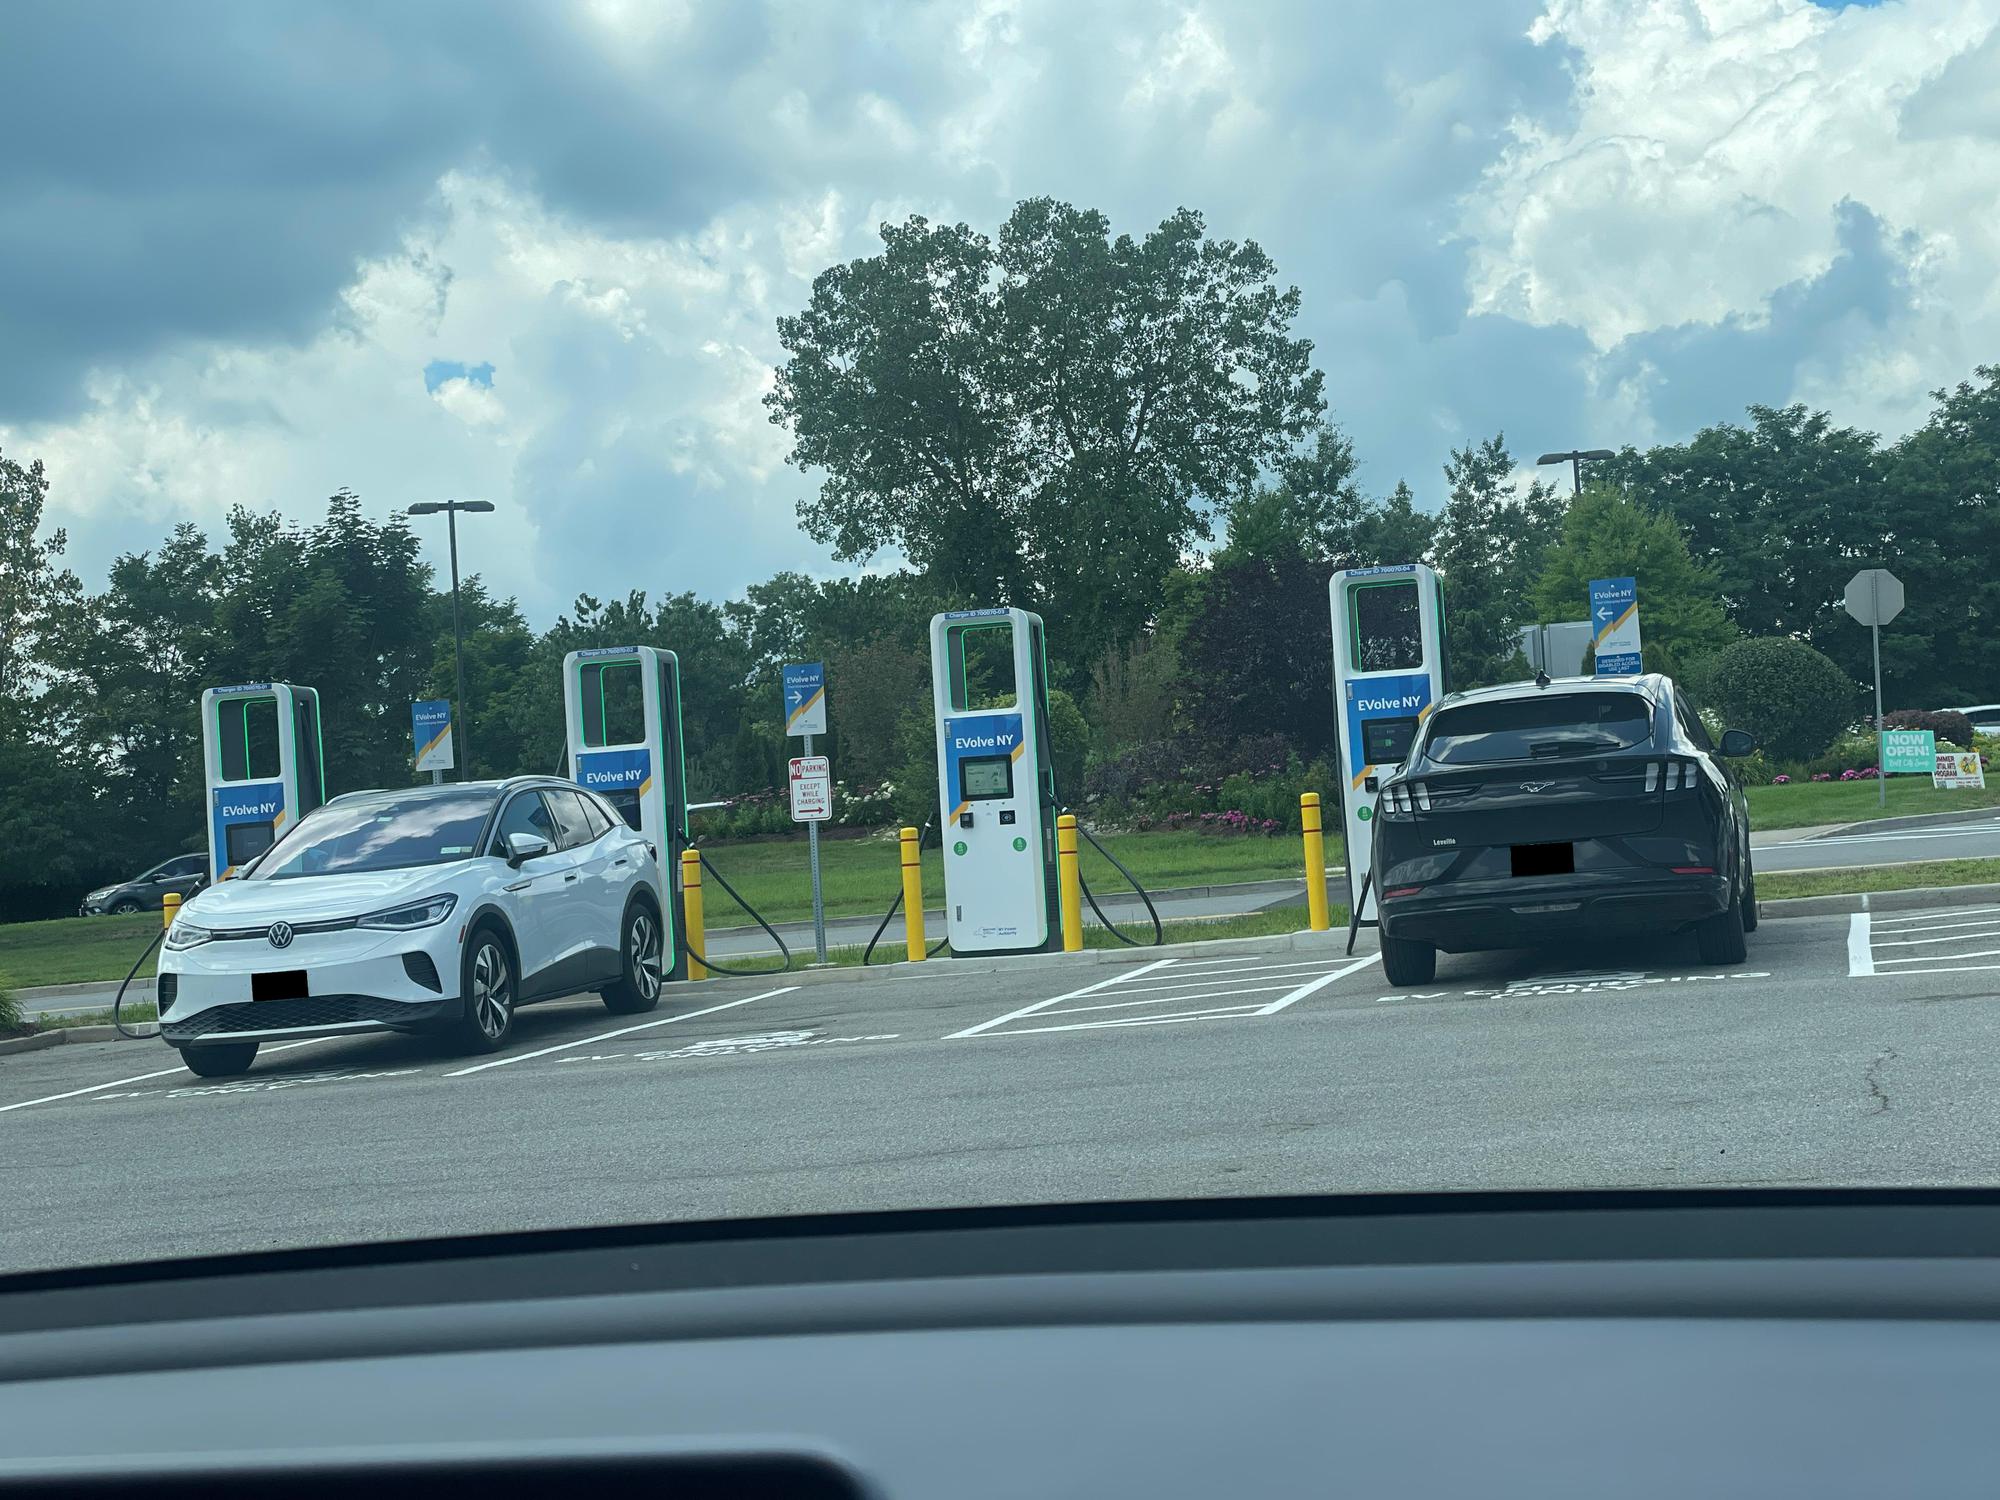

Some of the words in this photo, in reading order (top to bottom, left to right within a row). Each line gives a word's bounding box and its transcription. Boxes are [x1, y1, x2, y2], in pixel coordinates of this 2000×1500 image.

[1594, 591, 1620, 600] EVolve
[1621, 589, 1632, 597] NY
[786, 676, 809, 684] EVolve
[810, 674, 820, 682] NY
[1358, 697, 1400, 711] EVolve
[1402, 695, 1421, 708] NY
[415, 712, 437, 721] EVolve
[437, 711, 447, 719] NY
[955, 736, 995, 749] EVolve
[996, 734, 1014, 746] NY
[1888, 734, 1925, 745] NOW
[1886, 745, 1930, 757] OPEN!
[790, 763, 801, 776] NO
[801, 764, 826, 773] PARKING
[586, 771, 624, 785] EVolve
[625, 769, 642, 782] NY
[800, 783, 820, 791] EXCEPT
[802, 790, 819, 798] WHILE
[797, 797, 825, 806] CHARGING
[222, 803, 258, 817] EVolve
[259, 802, 276, 814] NY
[1376, 992, 1449, 1002] EV
[1464, 972, 1771, 996] CHARGING
[1490, 984, 1642, 1000] ONLY
